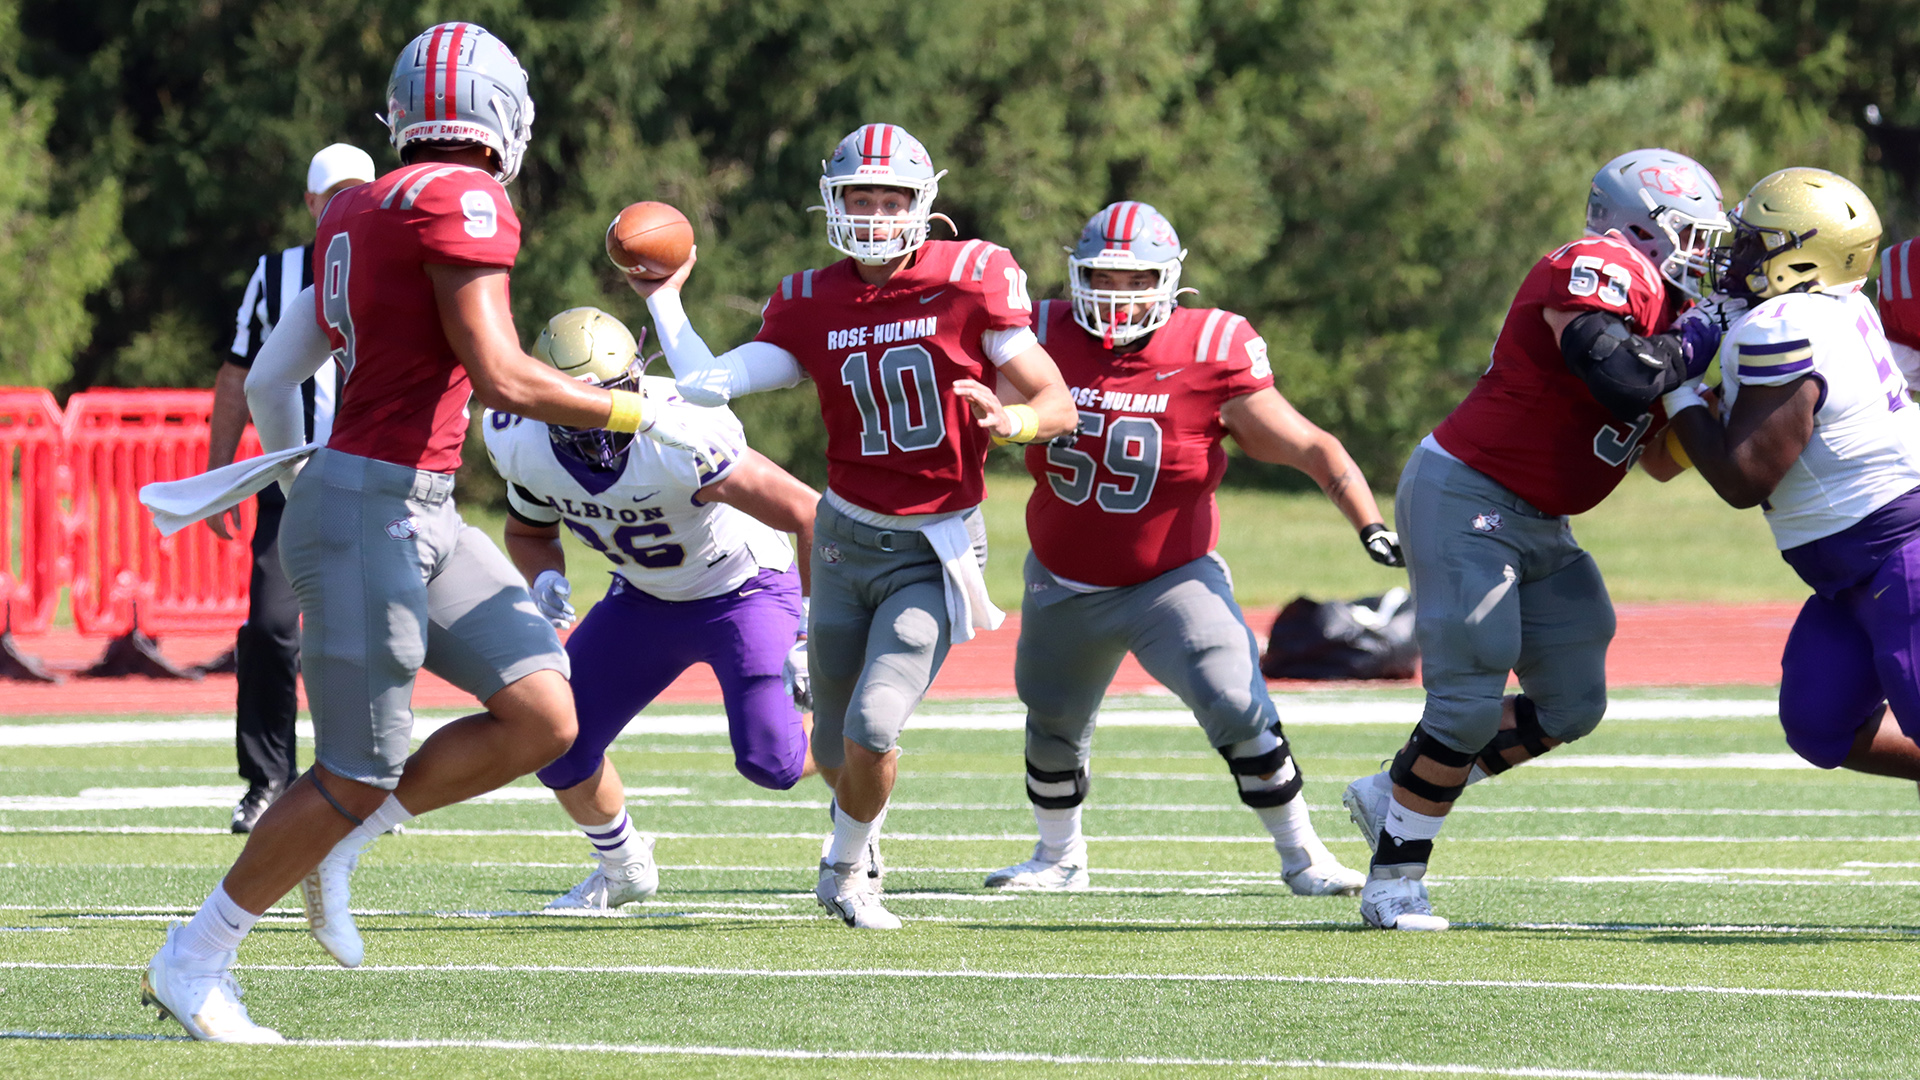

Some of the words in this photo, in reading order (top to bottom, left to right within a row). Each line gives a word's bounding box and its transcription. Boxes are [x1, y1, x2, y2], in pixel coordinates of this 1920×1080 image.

[440, 125, 489, 141] ENGINEERS
[460, 190, 497, 238] 9
[1567, 255, 1632, 307] 53
[323, 232, 356, 384] 9
[827, 316, 937, 350] ROSE-HULMAN
[1244, 336, 1273, 379] 5
[840, 343, 946, 456] 10
[1067, 384, 1170, 413] OSE-HULMAN
[1046, 411, 1163, 513] 59
[545, 495, 664, 523] ALBION
